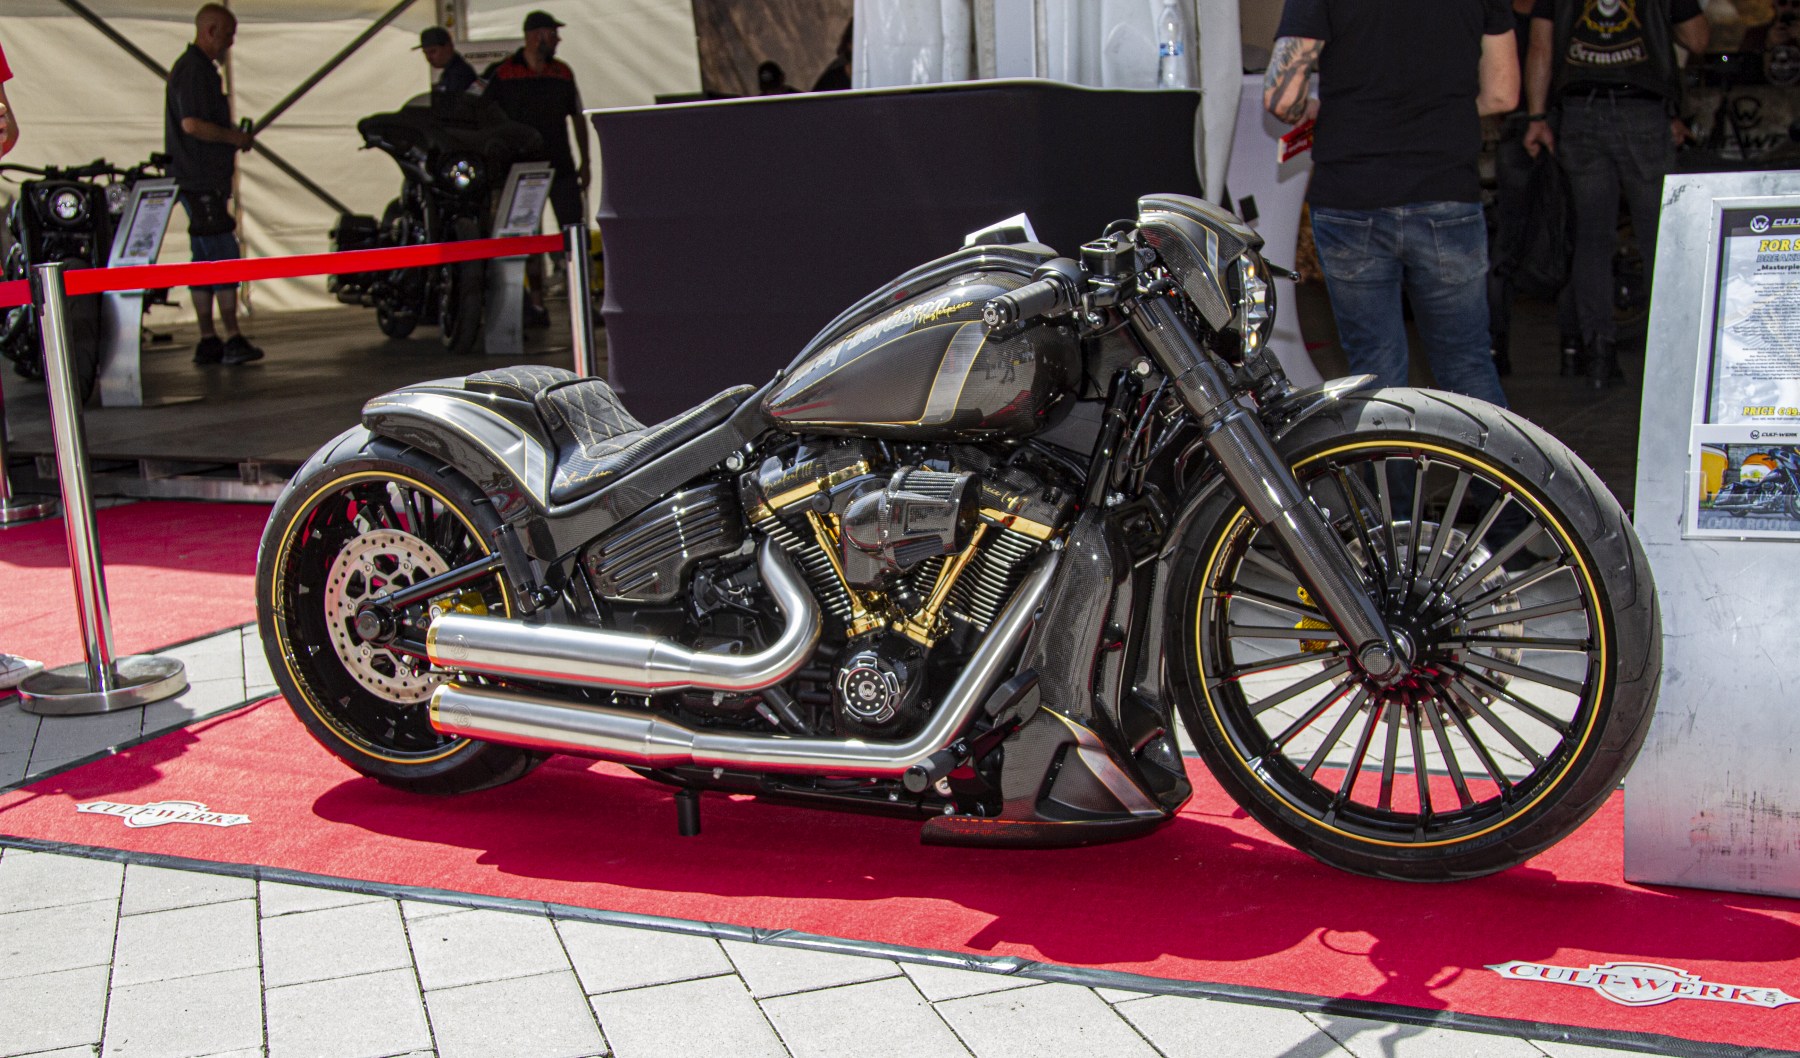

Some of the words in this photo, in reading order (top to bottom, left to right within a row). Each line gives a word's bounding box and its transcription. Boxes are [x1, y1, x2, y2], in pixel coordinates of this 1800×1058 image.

[1569, 43, 1643, 65] Germany
[1758, 239, 1792, 252] FOR
[1741, 405, 1775, 417] PRICE
[86, 802, 224, 824] CULT-WERK
[1508, 964, 1761, 1002] CULT-WERK
